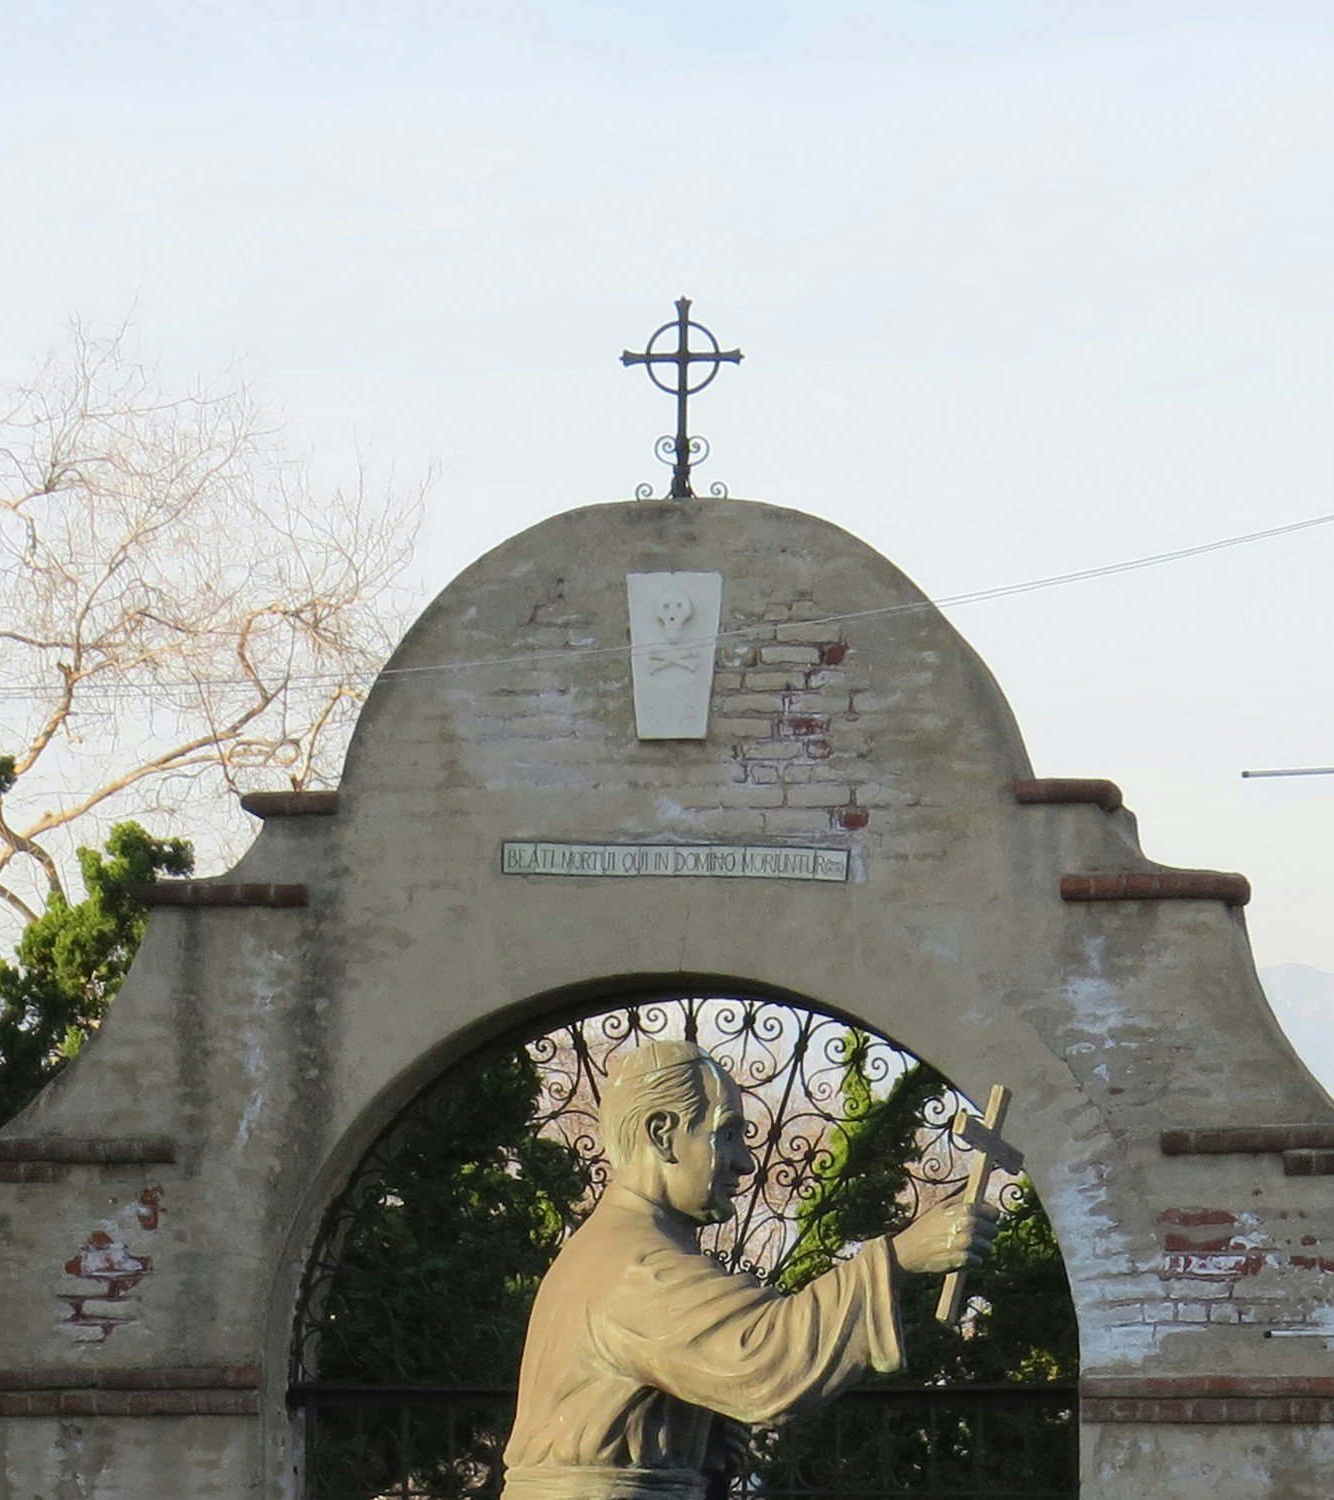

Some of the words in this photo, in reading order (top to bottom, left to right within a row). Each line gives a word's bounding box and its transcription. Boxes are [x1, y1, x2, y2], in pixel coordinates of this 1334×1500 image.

[507, 848, 556, 869] BEATI
[562, 849, 616, 871] MORTUI
[621, 851, 649, 873] QUI
[653, 852, 670, 873] IN
[675, 852, 736, 873] DOMINO
[742, 852, 825, 876] MORIUNTUR
